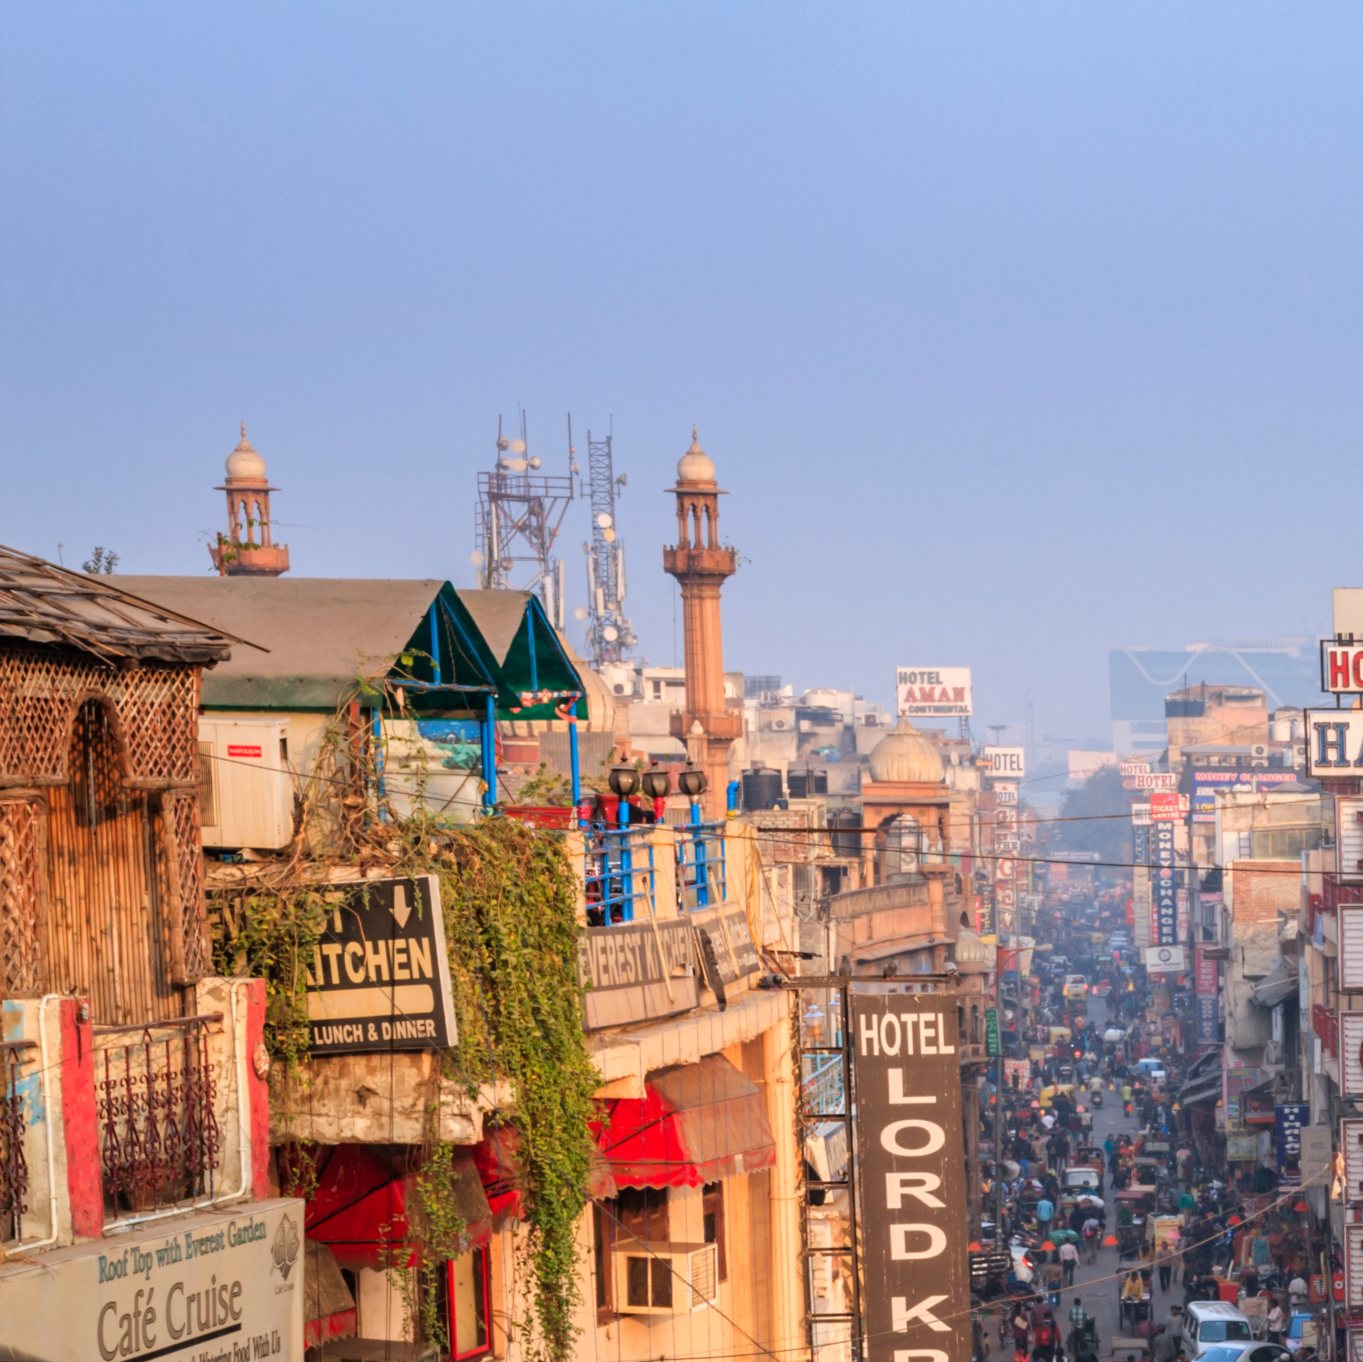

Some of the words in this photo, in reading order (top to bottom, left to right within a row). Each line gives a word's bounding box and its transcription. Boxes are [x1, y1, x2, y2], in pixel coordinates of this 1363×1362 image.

[899, 671, 943, 685] HOTEL
[904, 687, 965, 702] AMAN
[1136, 775, 1176, 788] HOTEL
[1152, 805, 1179, 813] TICKET
[1158, 822, 1173, 868] MONEY
[1159, 879, 1176, 944] CHANGER
[315, 1022, 363, 1046] LUNCH
[382, 1018, 437, 1041] DINNER
[861, 1012, 955, 1057] HOTEL
[880, 1067, 948, 1261] LORD
[166, 1273, 242, 1341] Cruise
